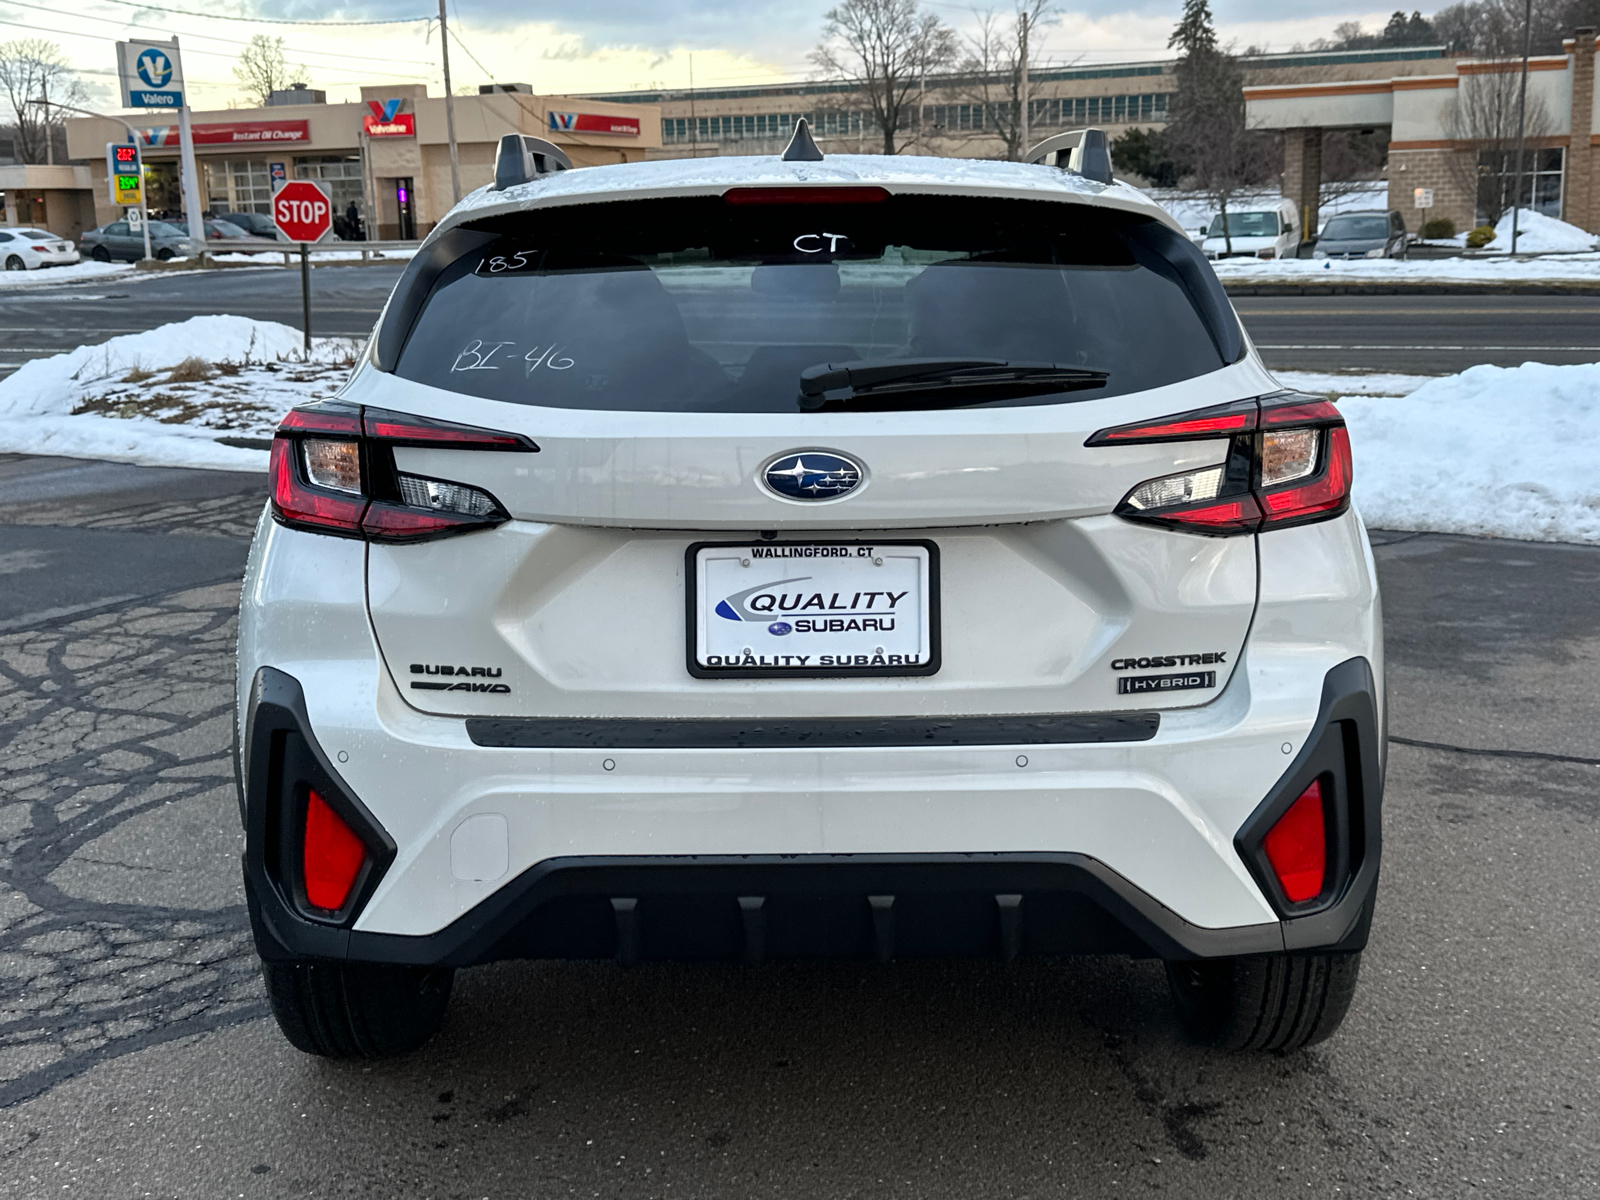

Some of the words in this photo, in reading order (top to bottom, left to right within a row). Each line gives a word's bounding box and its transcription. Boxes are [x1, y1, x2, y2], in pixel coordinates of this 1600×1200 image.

[141, 93, 174, 104] Valero
[233, 132, 260, 140] Instant
[261, 131, 272, 139] Oil
[272, 130, 302, 140] Change
[369, 124, 407, 134] Valvoline
[278, 199, 326, 224] STOP
[793, 232, 848, 253] CT
[475, 250, 539, 274] 185
[857, 547, 874, 557] CT
[750, 591, 909, 612] QUALITY
[795, 618, 895, 632] SUBARU
[706, 655, 811, 666] QUALITY
[819, 654, 920, 666] SUBARU
[1111, 652, 1227, 670] CROSSTREK
[410, 664, 502, 677] SUBARU
[447, 682, 511, 693] AWD
[1135, 677, 1201, 689] HYBRID
